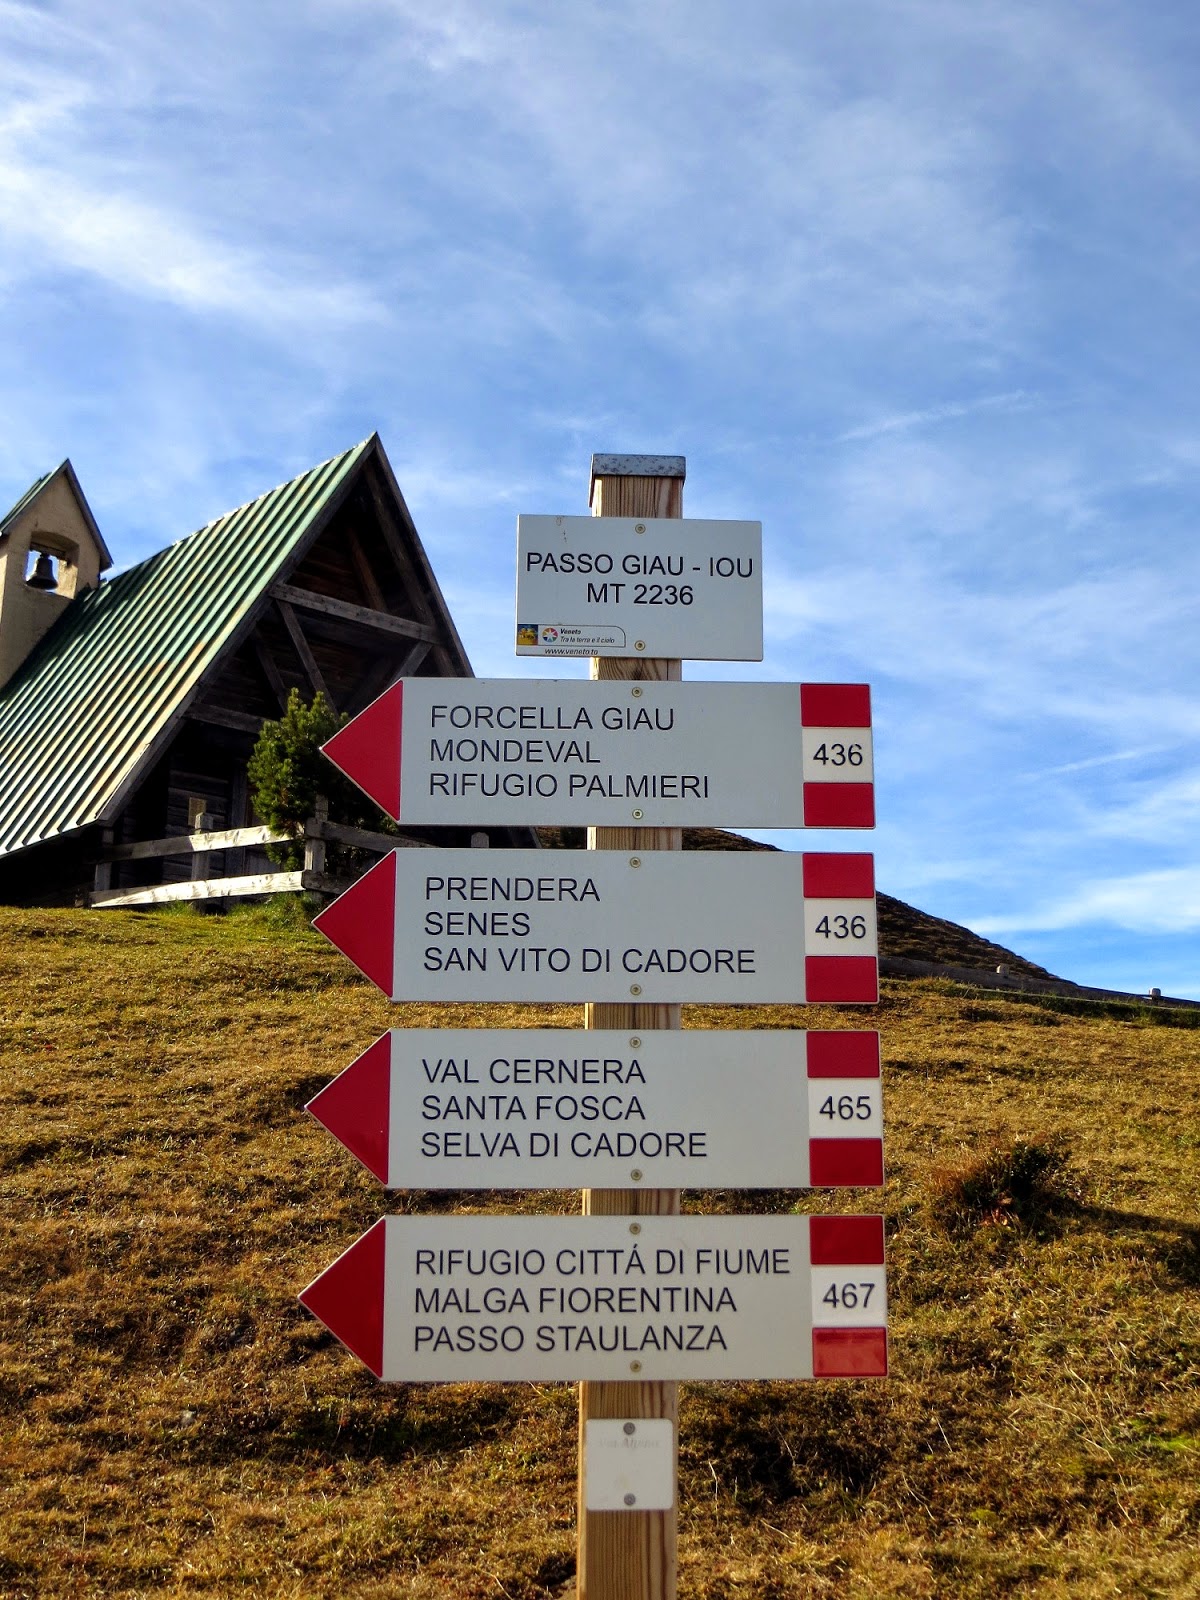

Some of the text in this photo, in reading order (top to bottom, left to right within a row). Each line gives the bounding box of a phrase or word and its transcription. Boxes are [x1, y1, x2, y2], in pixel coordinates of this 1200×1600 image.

[526, 551, 614, 575] PASSO
[621, 554, 684, 577] GIAU
[709, 556, 753, 579] IOU
[587, 582, 694, 606] MT 2236
[431, 705, 674, 731] FORCELLA GIAU
[430, 738, 601, 764] MONDEVAL
[812, 743, 863, 767] 436
[429, 772, 709, 799] RIFUGIO PALMIERI
[425, 876, 601, 902] PRENDERA
[424, 911, 531, 937] SENES
[815, 915, 867, 940] 436
[423, 946, 756, 974] SAN VITO DI CADORE
[421, 1058, 647, 1084] VAL CERNERA
[421, 1094, 646, 1121] SANTA FOSCA
[819, 1095, 872, 1121] 465
[420, 1131, 708, 1158] SELVA DI CADORE
[415, 1243, 791, 1276] RIFUGIO CITTÁ DI FIUME
[415, 1286, 738, 1314] MALGA FIORENTINA
[822, 1282, 875, 1309] 467
[414, 1324, 728, 1353] PASSO STAULANZA
